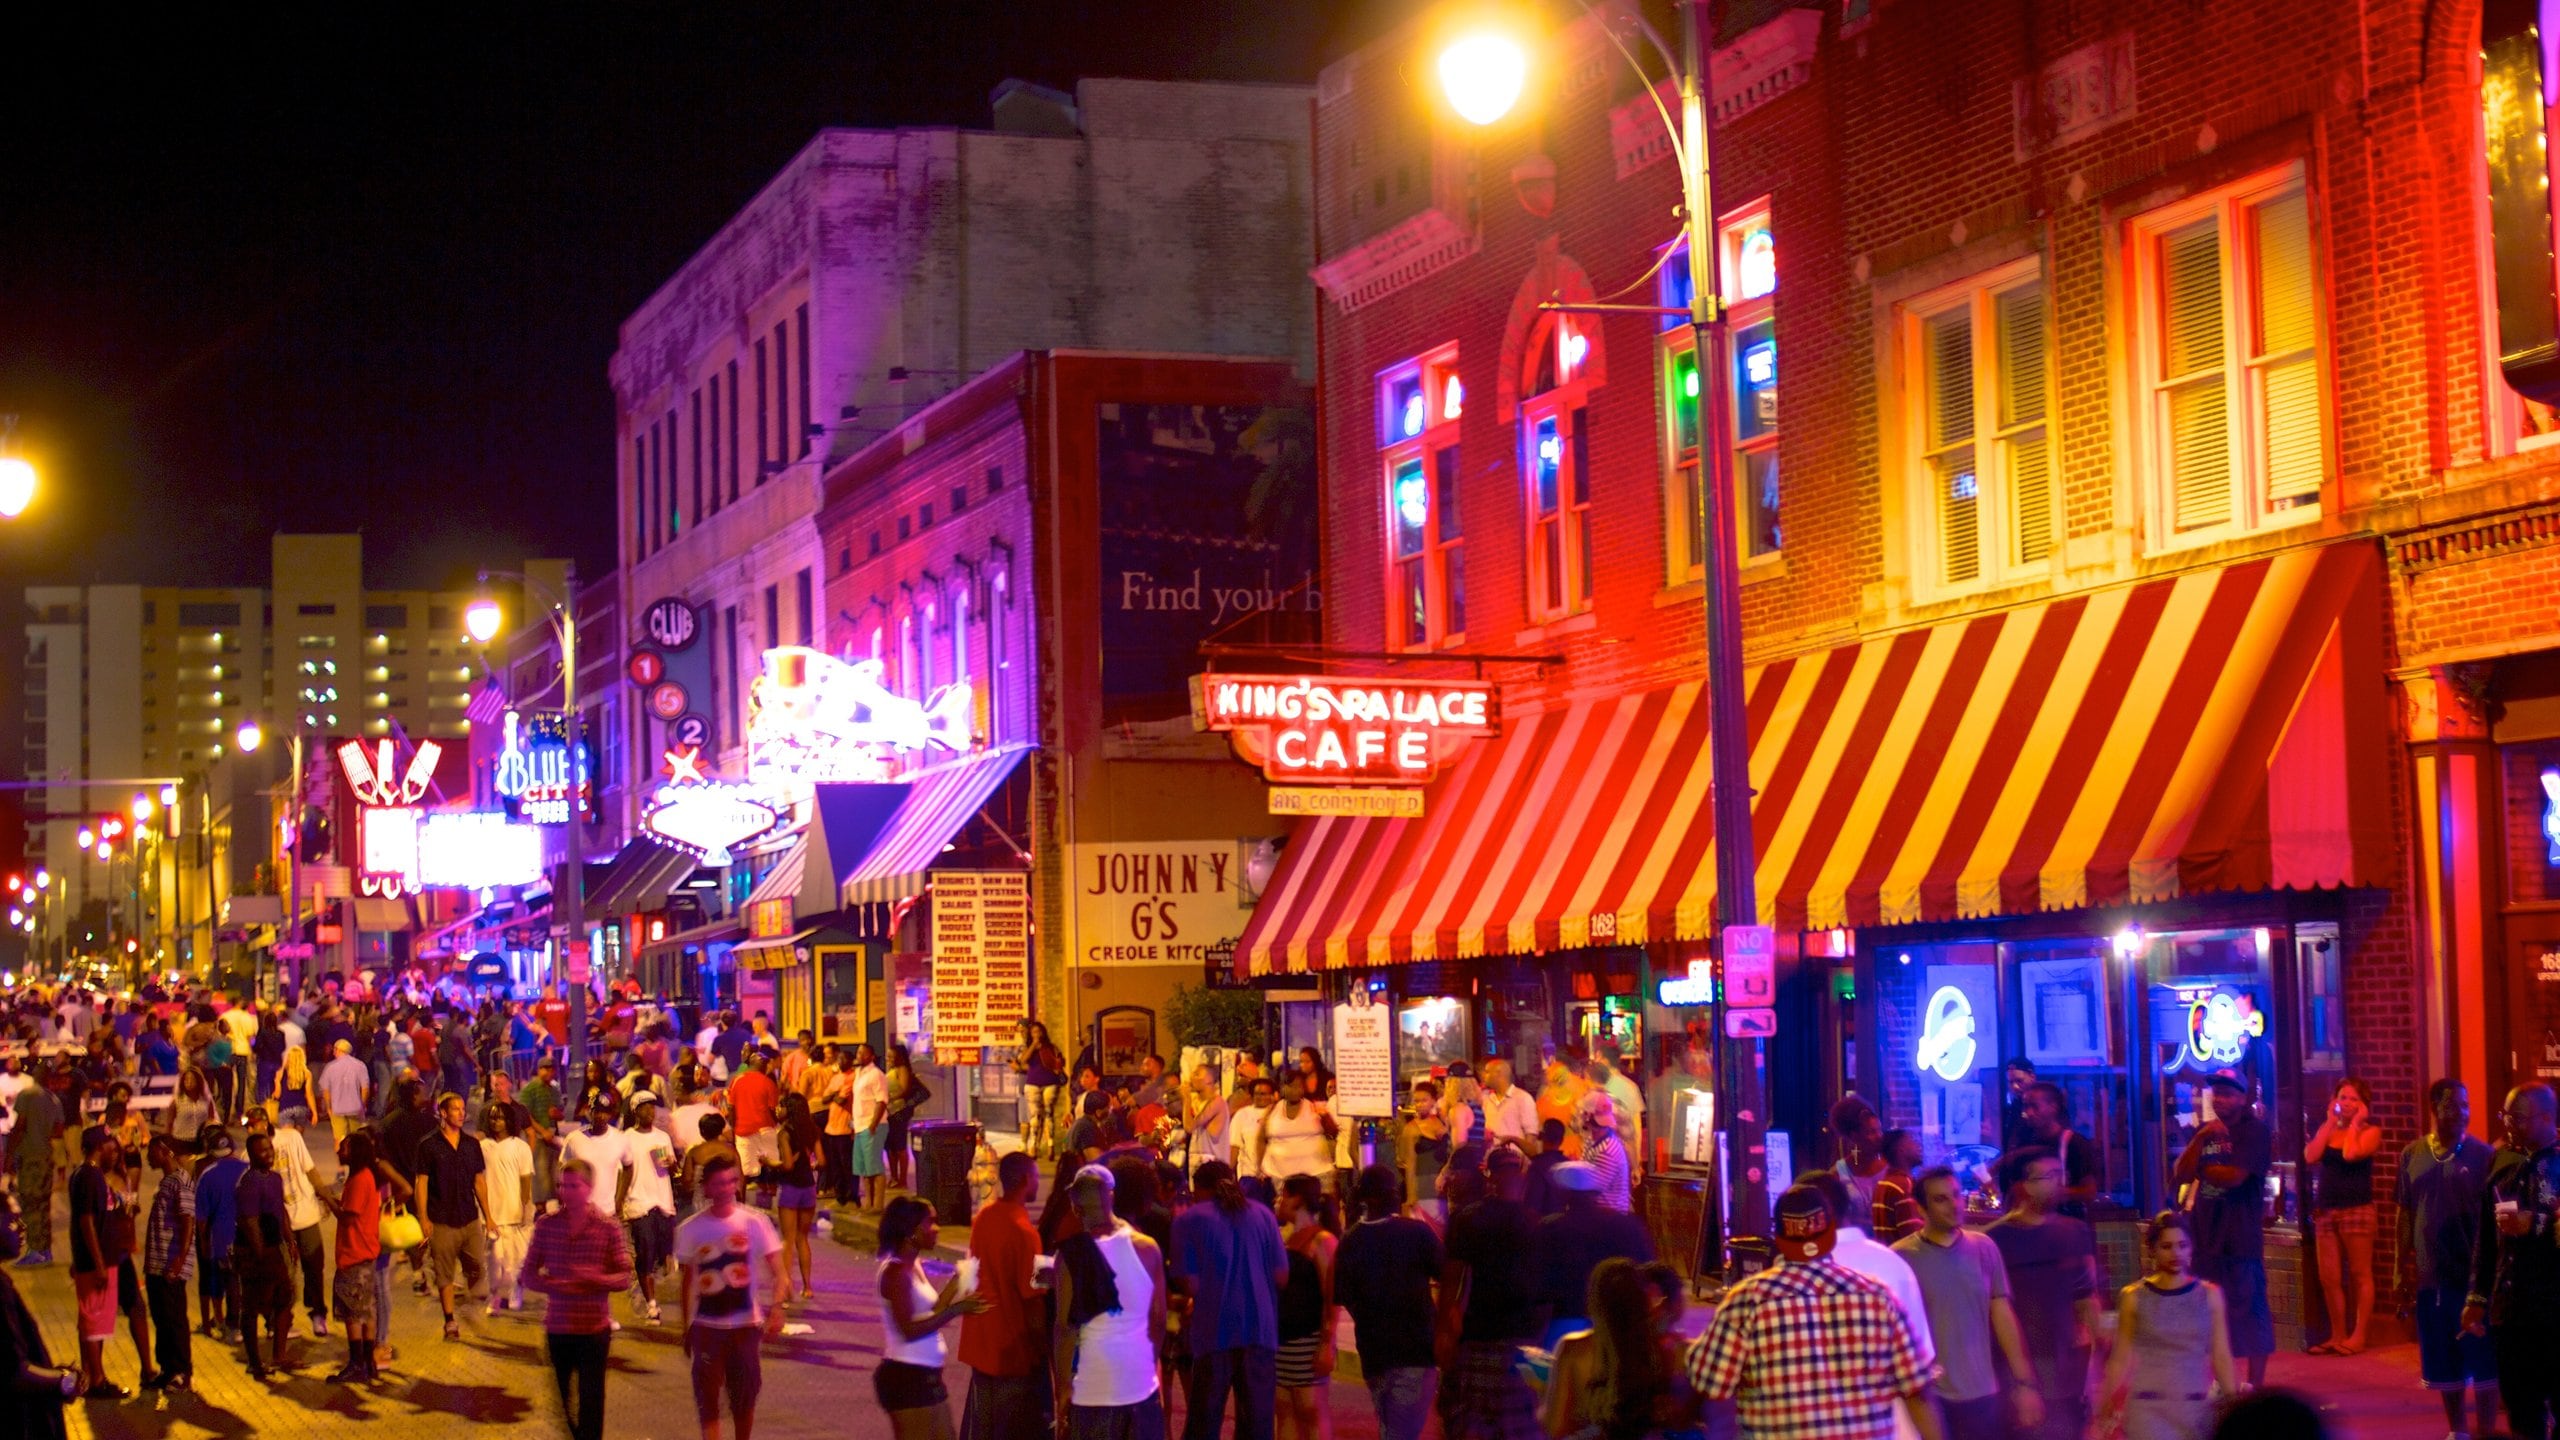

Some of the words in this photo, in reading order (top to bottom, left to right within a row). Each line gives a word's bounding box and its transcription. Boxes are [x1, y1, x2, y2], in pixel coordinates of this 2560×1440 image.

[1120, 568, 1200, 611] Find
[1211, 588, 1293, 625] your
[650, 602, 693, 646] CLUB
[1217, 679, 1332, 721] KING'S
[1330, 689, 1488, 727] PALACE
[1087, 853, 1229, 896] JOHNNY
[982, 877, 1002, 885] RAW
[1005, 877, 1023, 885] BAR
[934, 889, 978, 897] CRAWFISH
[982, 888, 1023, 896] OYSTERS
[941, 901, 973, 909] SALADS
[1131, 895, 1179, 940] G'S
[1590, 913, 1616, 937] 162
[938, 934, 976, 942] GREENS
[1734, 931, 1762, 950] NO
[944, 946, 972, 954] FRIED
[1089, 945, 1158, 961] CREOLE
[937, 956, 978, 964] PICKLES
[938, 1012, 976, 1020] PO-BOY
[937, 1025, 979, 1033] STUFFED
[995, 1033, 1015, 1041] STEW
